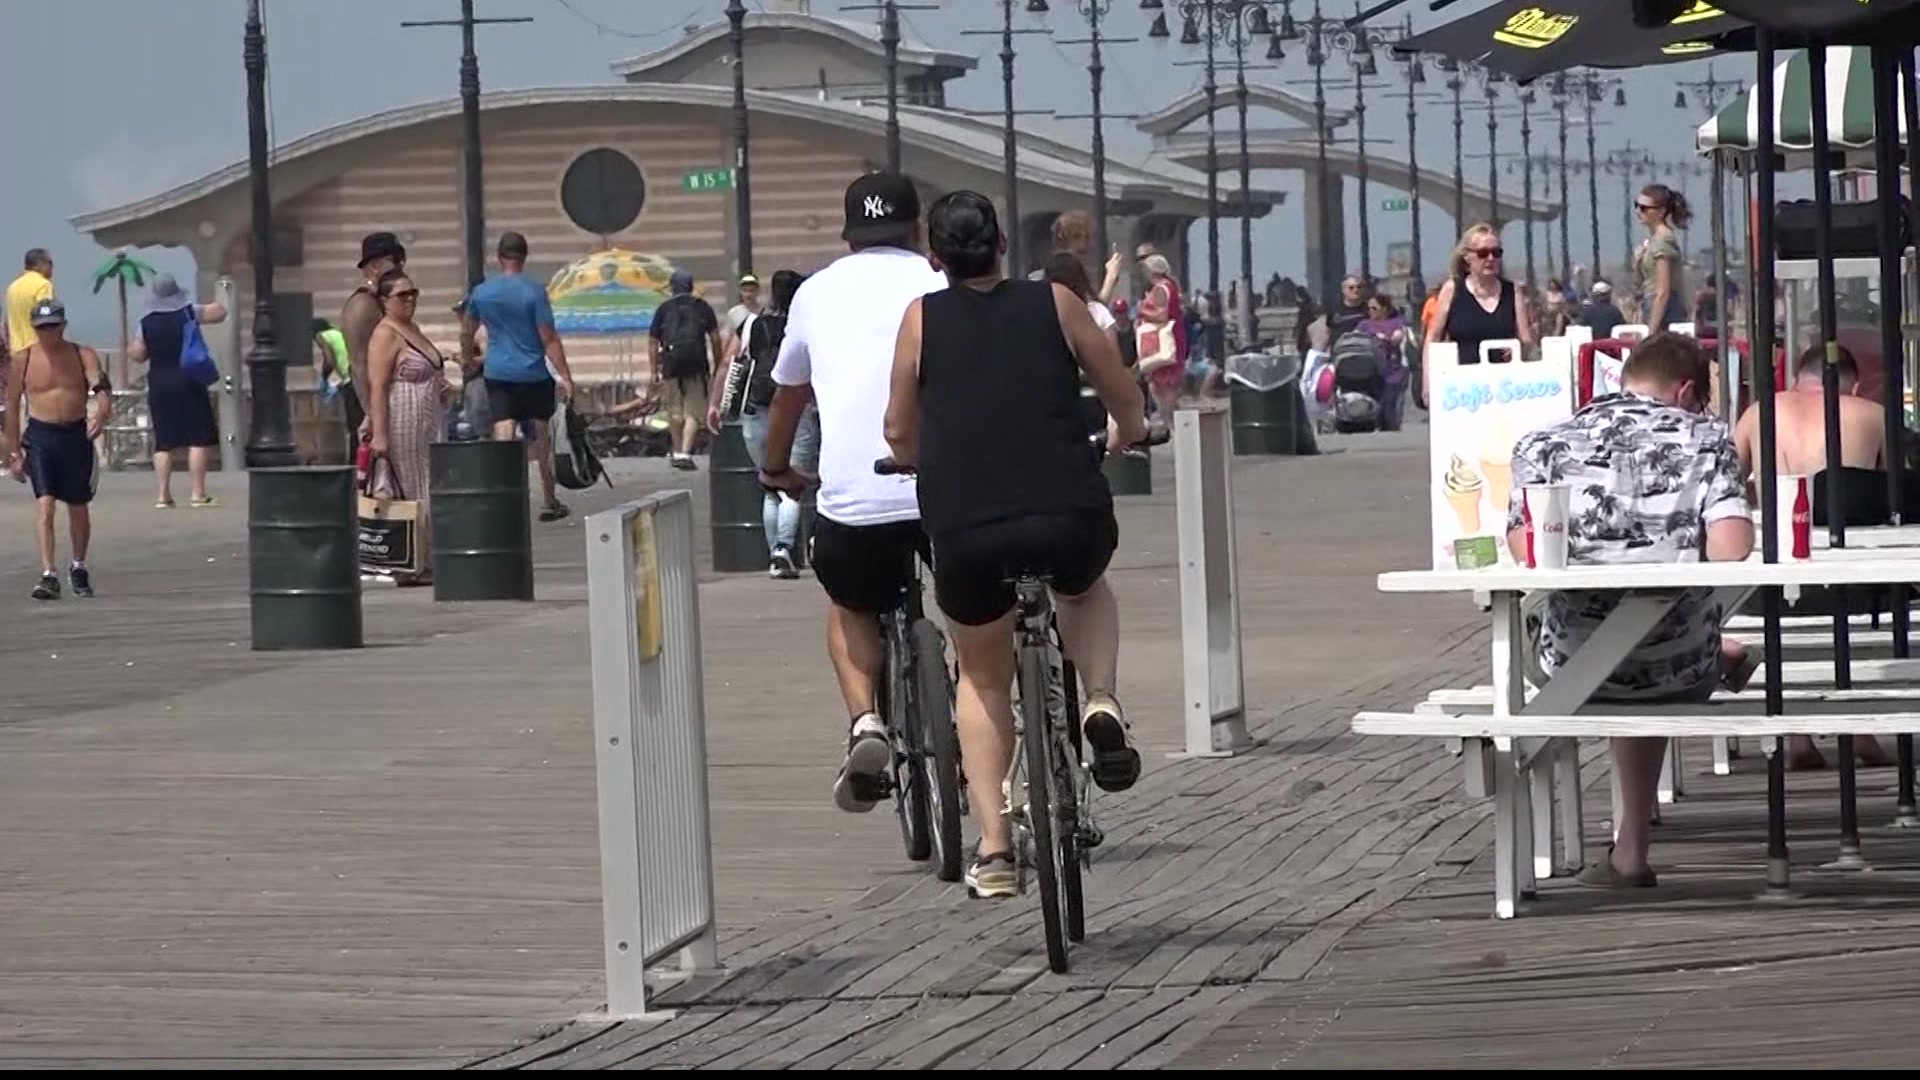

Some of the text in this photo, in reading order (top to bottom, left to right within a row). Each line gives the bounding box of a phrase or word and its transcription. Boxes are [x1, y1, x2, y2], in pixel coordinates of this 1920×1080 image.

[689, 175, 699, 188] W
[863, 195, 885, 218] NY
[1441, 378, 1562, 413] Soft Serve
